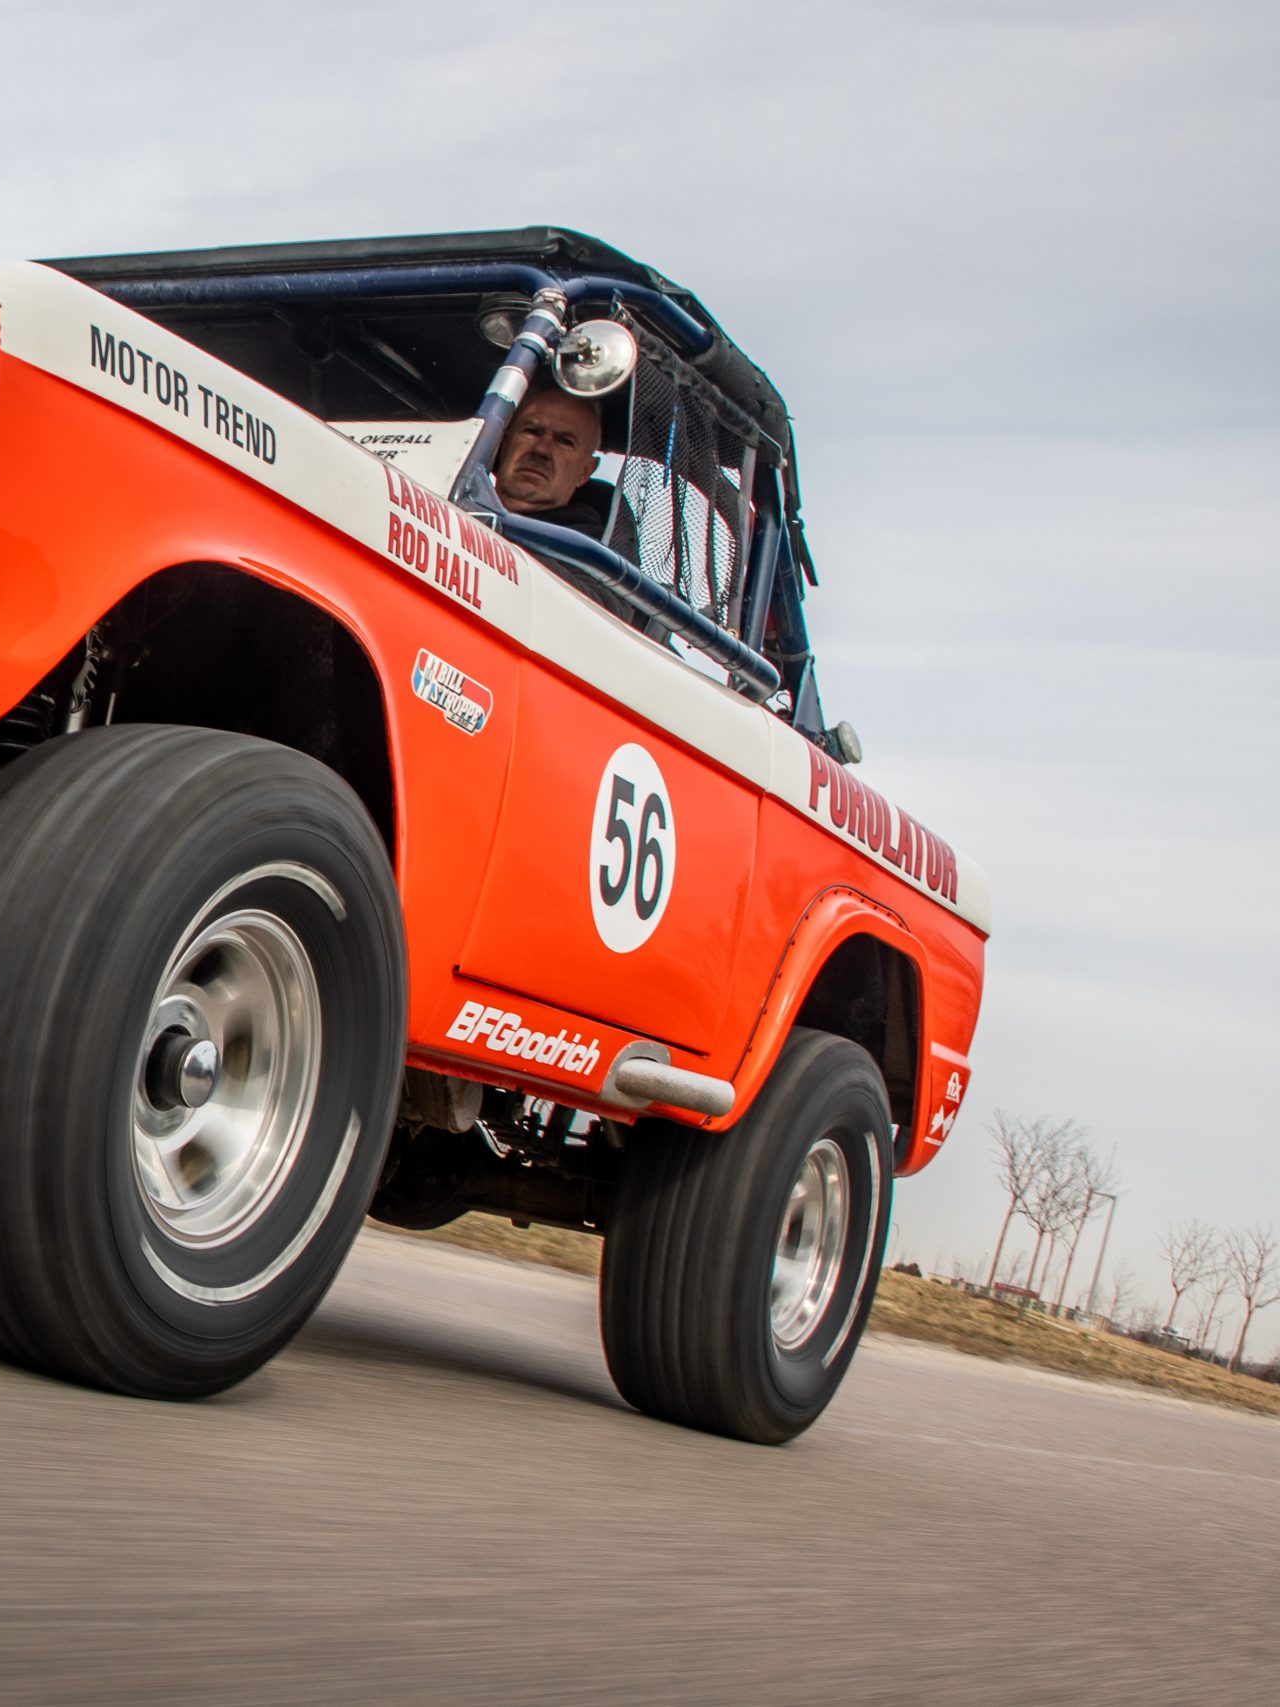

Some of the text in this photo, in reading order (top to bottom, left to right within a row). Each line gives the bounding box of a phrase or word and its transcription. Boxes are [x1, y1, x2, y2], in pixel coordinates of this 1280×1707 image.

[90, 324, 276, 465] MOTOR TREND
[360, 434, 432, 444] OVERALL
[382, 464, 519, 586] LARRY MINOR
[387, 511, 482, 610] ROD HALL
[436, 661, 465, 696] BILL
[599, 773, 667, 921] 56
[806, 741, 958, 906] PUROLATOR
[445, 1000, 601, 1076] BFGoodrich
